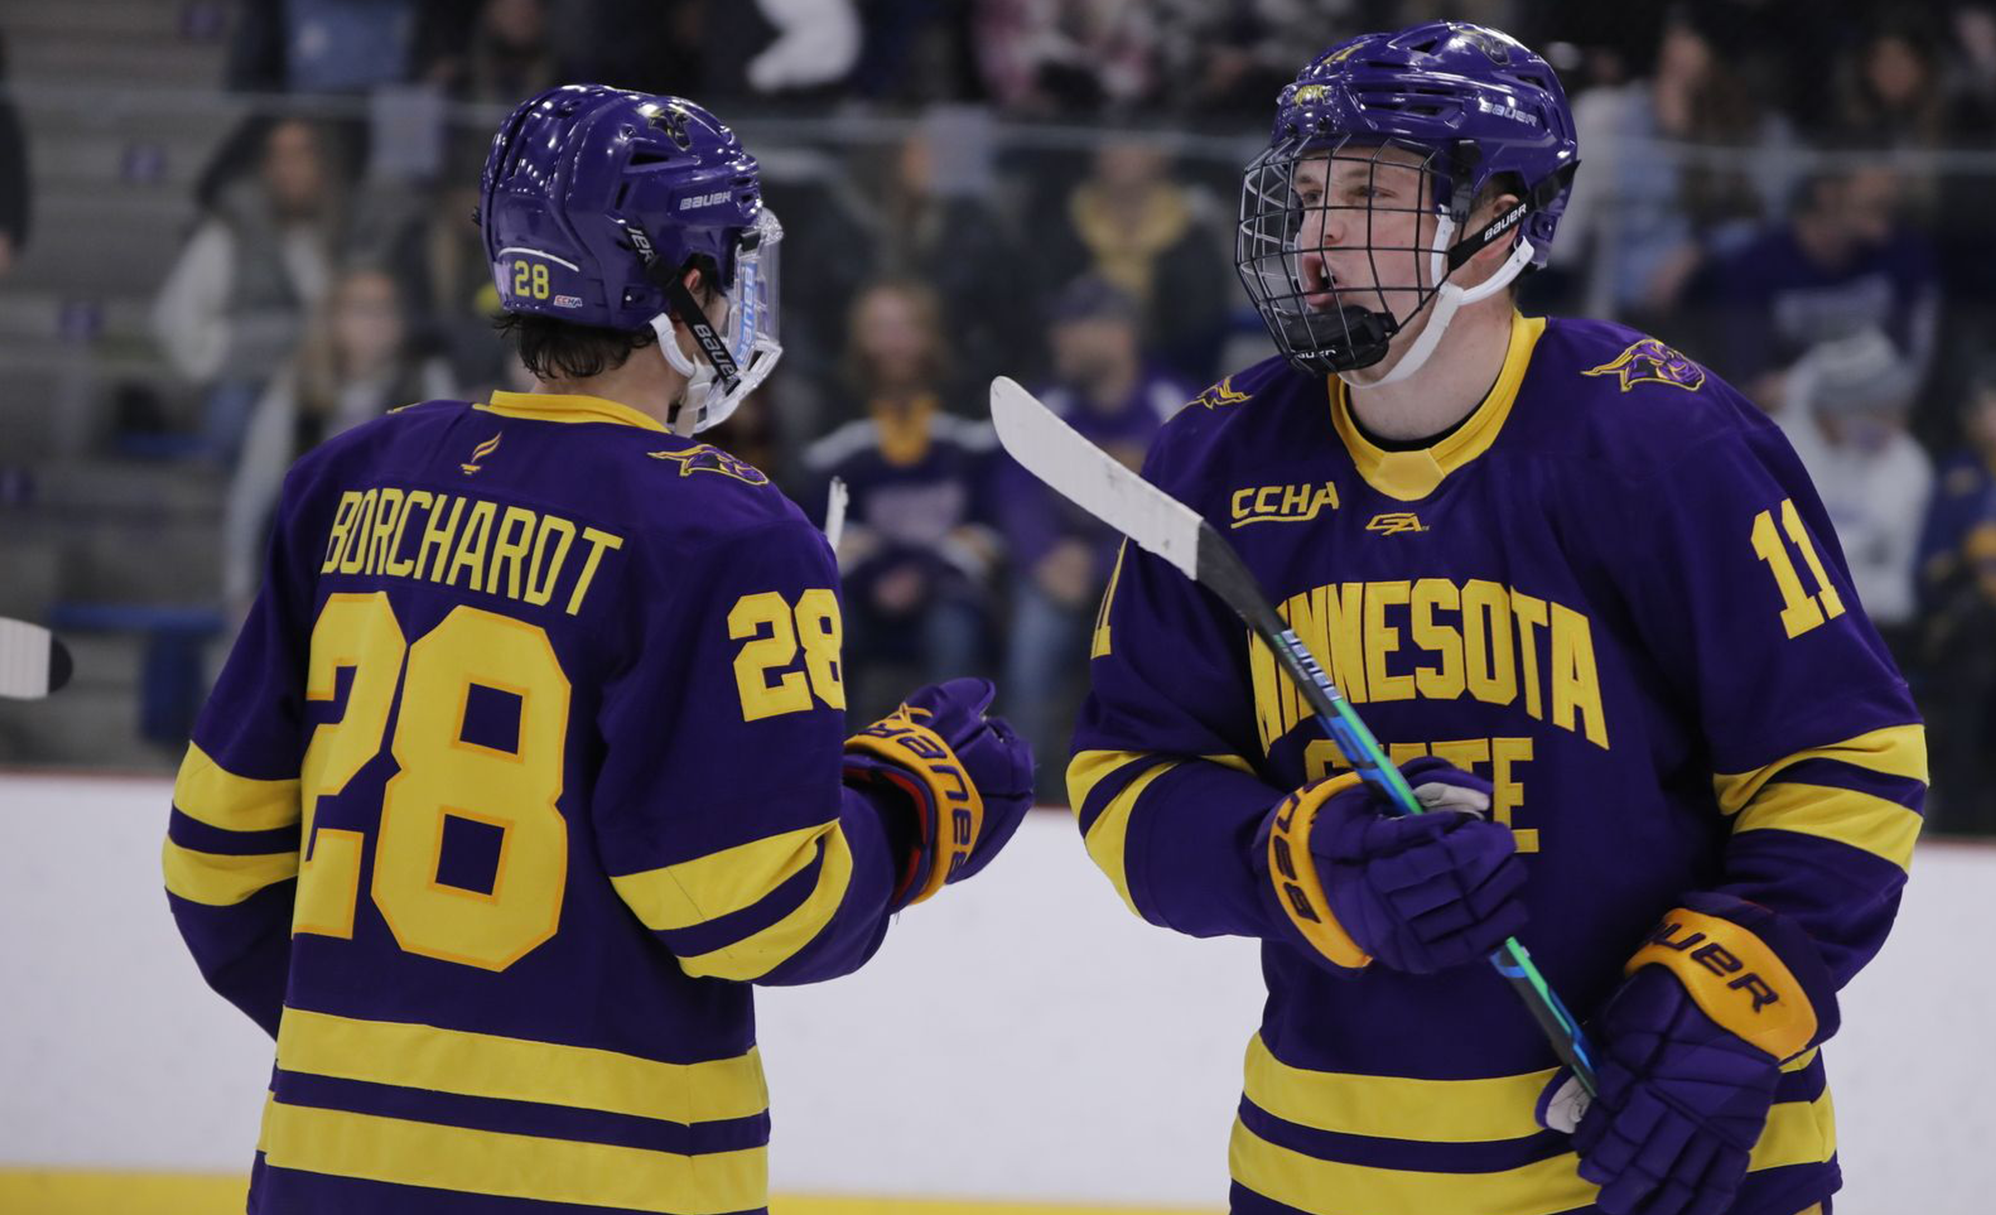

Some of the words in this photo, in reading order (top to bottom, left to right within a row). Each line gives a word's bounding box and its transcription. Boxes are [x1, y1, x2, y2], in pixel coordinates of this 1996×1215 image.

[680, 191, 731, 210] BAUER
[1484, 203, 1526, 241] BAUER
[514, 260, 550, 300] 28
[1231, 482, 1339, 528] CCHA
[320, 487, 623, 616] BORCHARDT
[1751, 498, 1846, 639] 11
[727, 588, 846, 722] 28
[291, 590, 571, 972] 28
[1652, 923, 1779, 1013] UER
